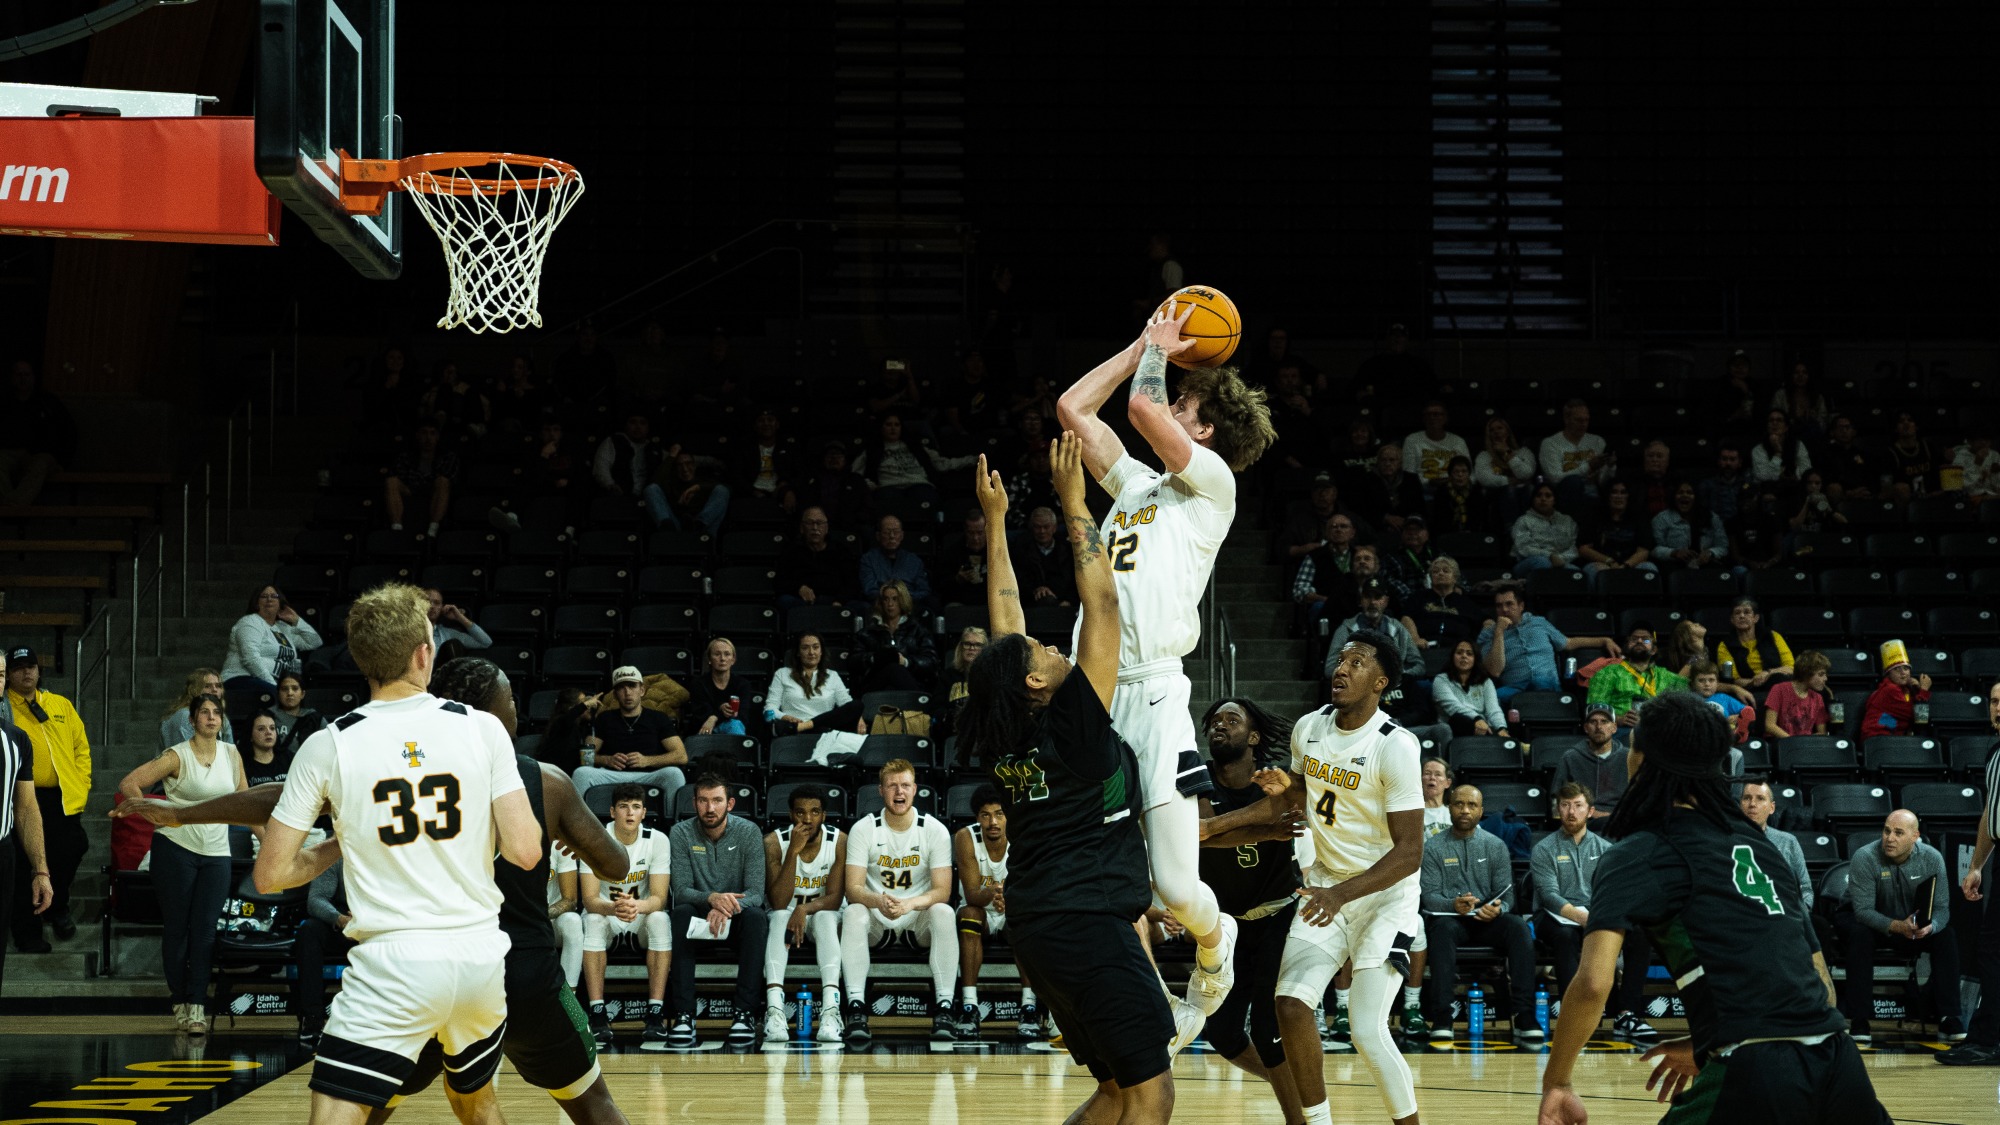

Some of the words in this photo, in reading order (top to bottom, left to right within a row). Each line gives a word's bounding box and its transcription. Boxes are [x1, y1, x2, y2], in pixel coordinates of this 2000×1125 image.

[0, 165, 69, 202] rm
[995, 747, 1050, 805] 44
[1303, 755, 1361, 790] IDAHO
[372, 773, 462, 847] 33
[1316, 789, 1336, 827] 4
[877, 855, 920, 868] IDAHO
[795, 875, 828, 888] DAHO
[881, 870, 912, 890] 34
[1731, 845, 1785, 915] 4
[257, 994, 280, 1002] Idaho
[256, 1001, 287, 1009] Central
[624, 1007, 647, 1015] Centr
[709, 1006, 733, 1014] Centr
[896, 1003, 927, 1011] Central
[995, 1007, 1021, 1015] Centra
